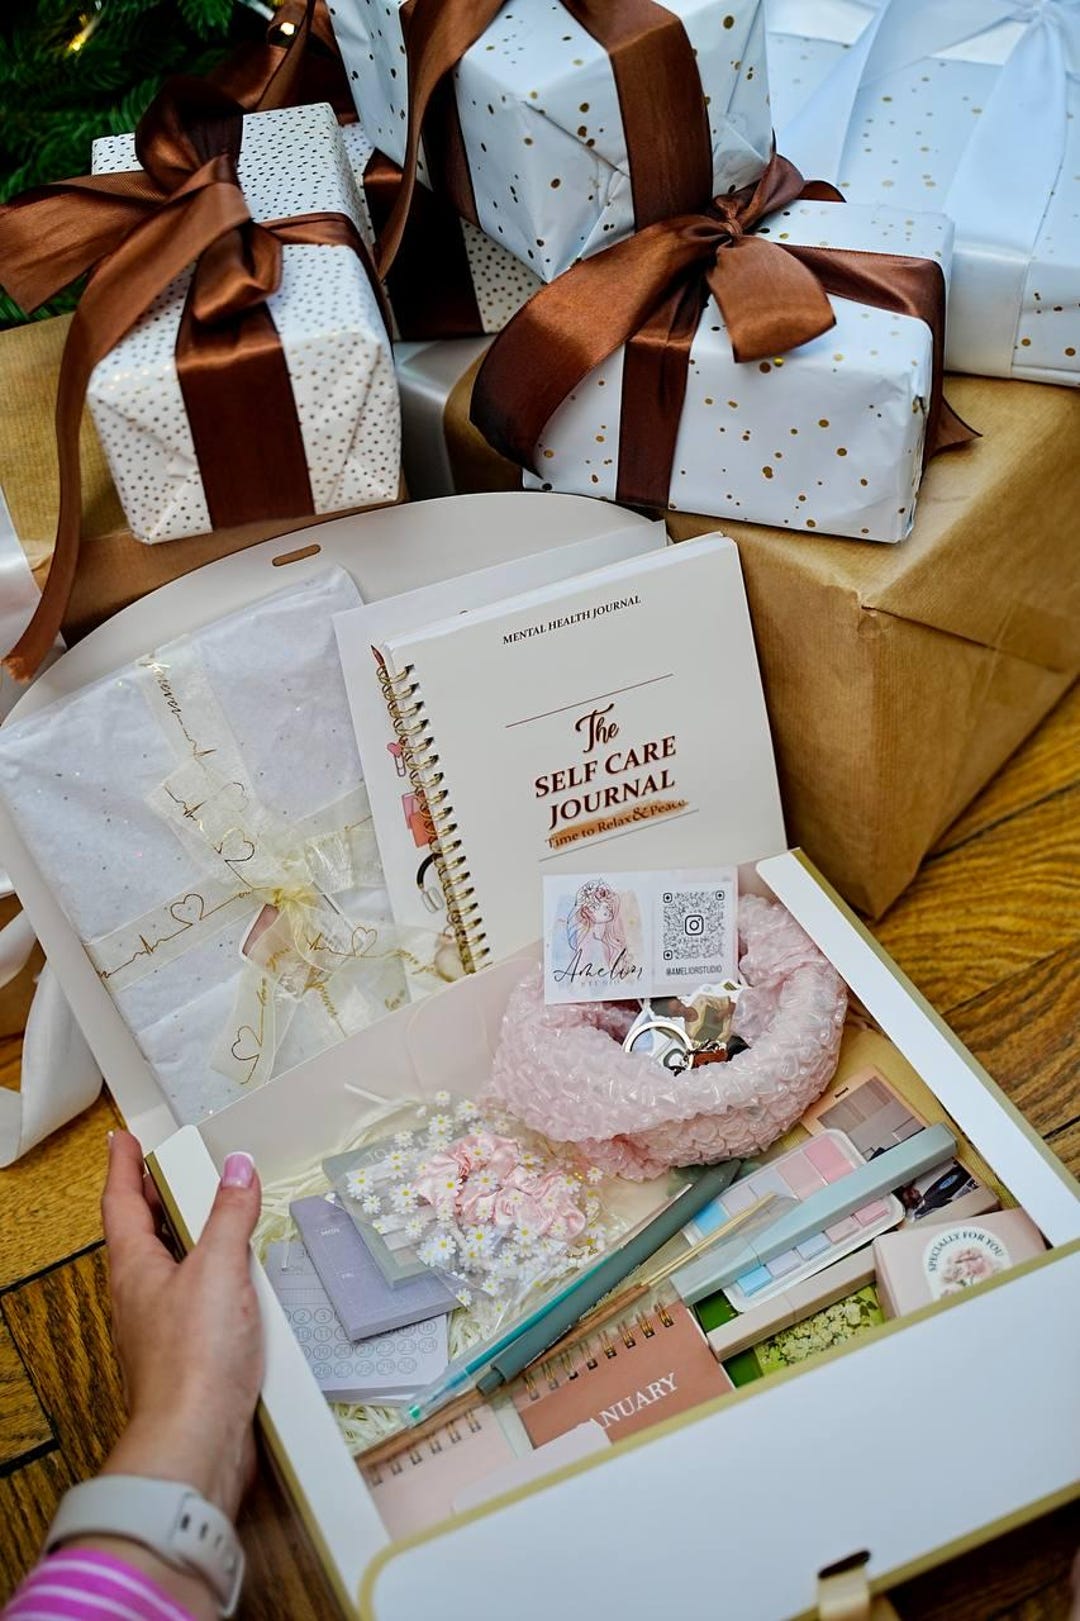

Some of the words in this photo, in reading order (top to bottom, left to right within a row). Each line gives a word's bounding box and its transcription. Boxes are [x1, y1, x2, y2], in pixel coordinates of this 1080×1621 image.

[503, 624, 546, 645] MENTAL
[548, 610, 591, 632] HEALTH
[591, 595, 642, 619] JOURNAL
[575, 703, 619, 753] The
[535, 761, 597, 798] SELF
[604, 735, 677, 774] CARE
[548, 769, 676, 830] JOURNAL
[545, 833, 579, 849] Time
[581, 827, 595, 838] to
[928, 1231, 962, 1273] SPECIALLY
[962, 1231, 984, 1241] FOR
[985, 1237, 1005, 1257] YOU
[589, 1372, 678, 1428] NUARY
